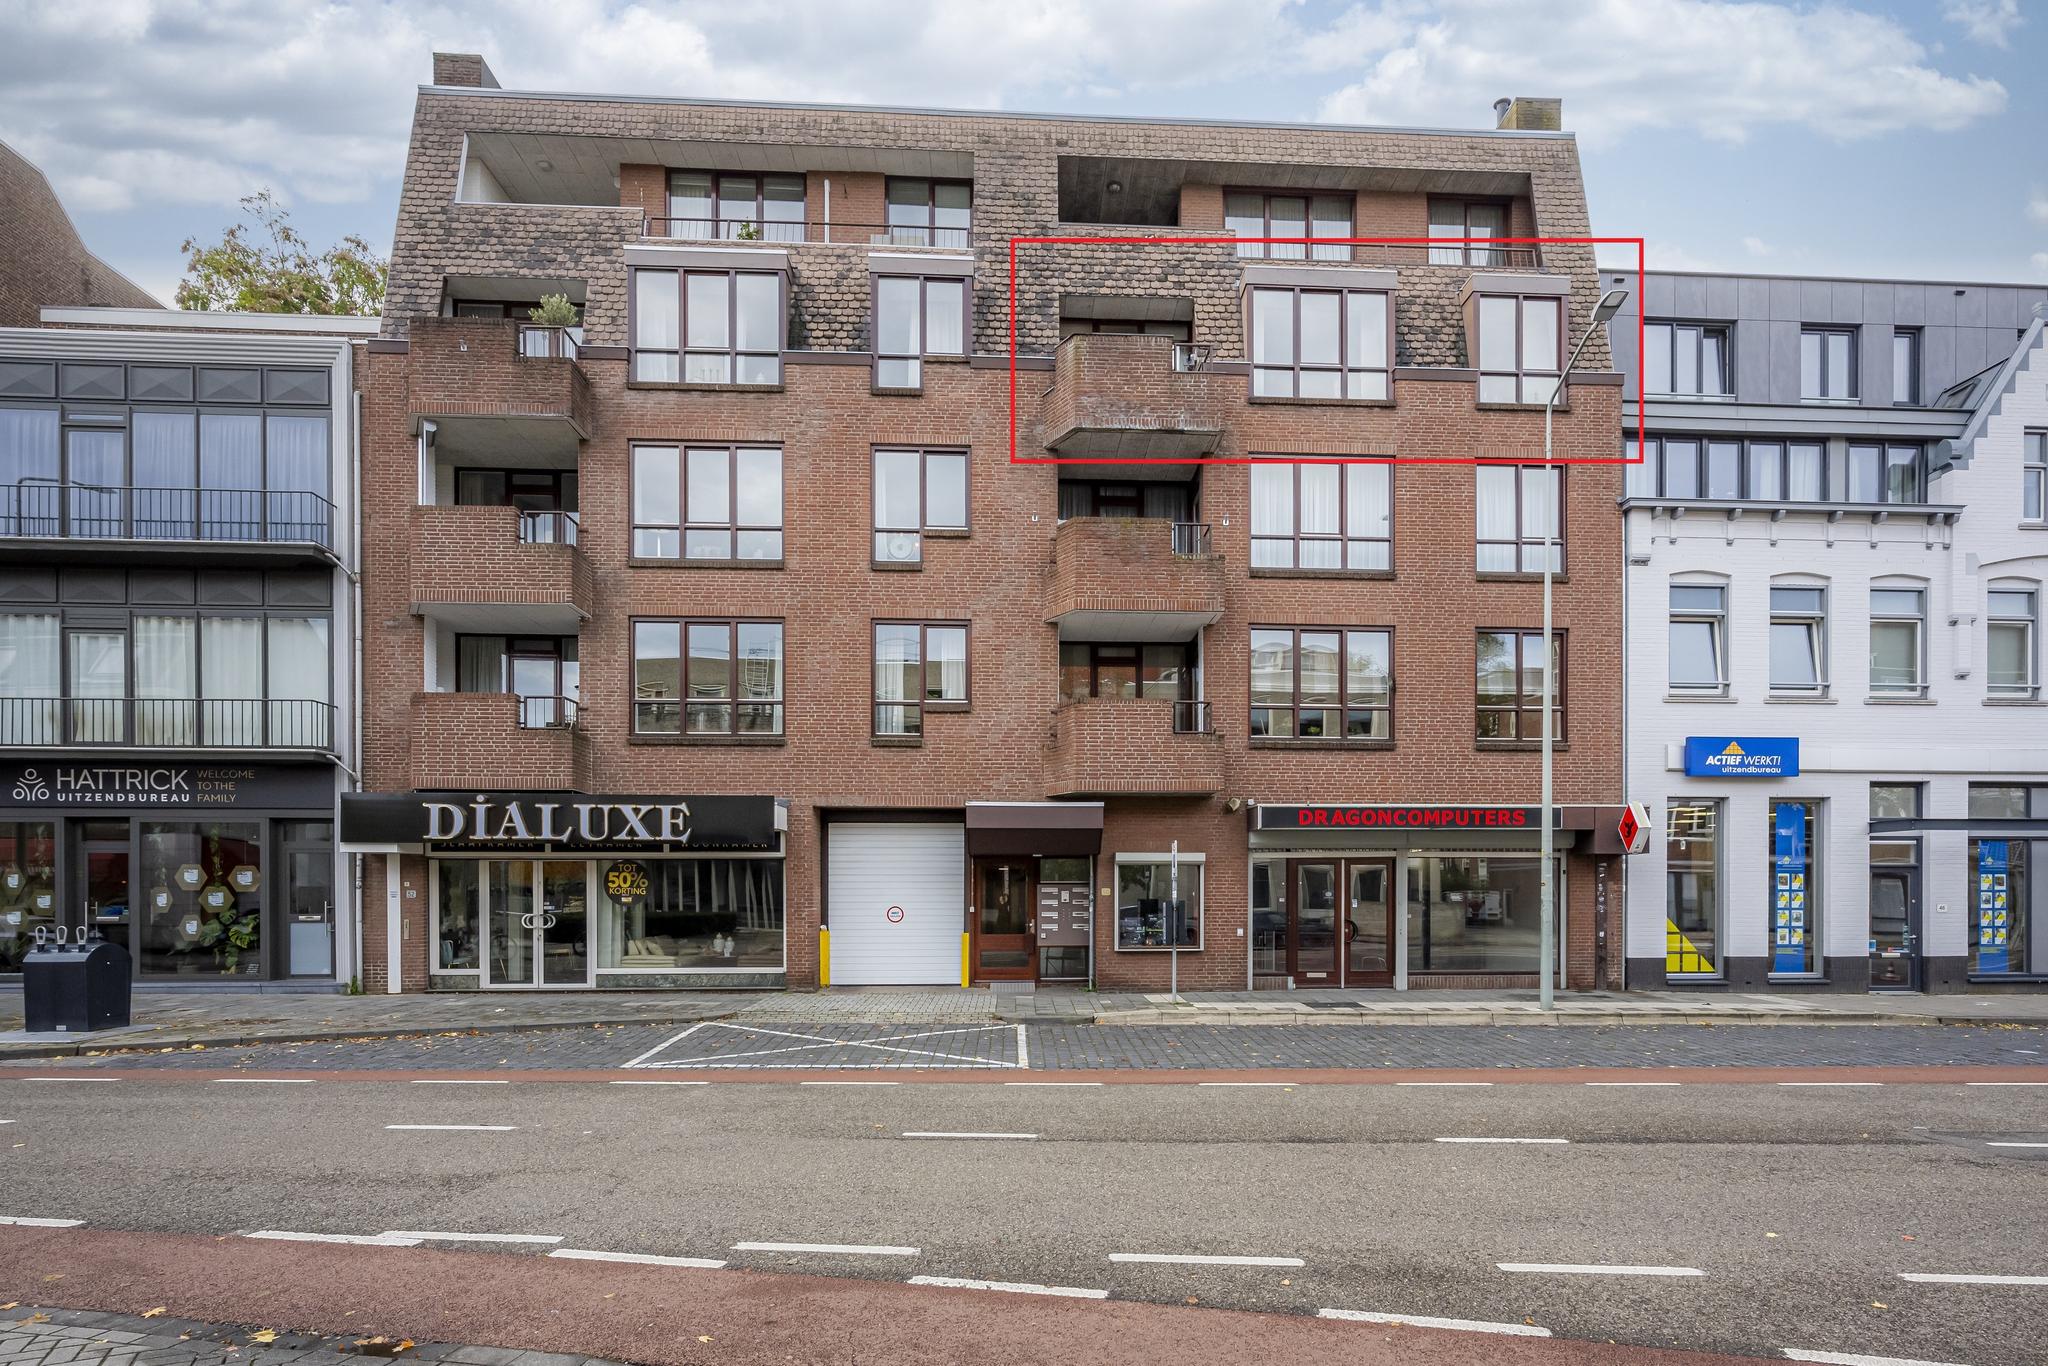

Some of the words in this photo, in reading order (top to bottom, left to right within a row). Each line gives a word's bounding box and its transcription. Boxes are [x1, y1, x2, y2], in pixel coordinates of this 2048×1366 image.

[1705, 755, 1742, 766] ACTIEF
[197, 769, 255, 779] WELCOME
[1722, 766, 1781, 774] uitzendbureau
[56, 768, 189, 791] HATTRICK
[197, 781, 212, 791] TO
[213, 781, 236, 791] THE
[57, 793, 190, 802] UITZENDBUREAU
[197, 794, 236, 803] FAMILY
[1299, 809, 1525, 826] DRAGONCOMPUTERS
[617, 864, 637, 872] TOT
[607, 871, 648, 888] 50%
